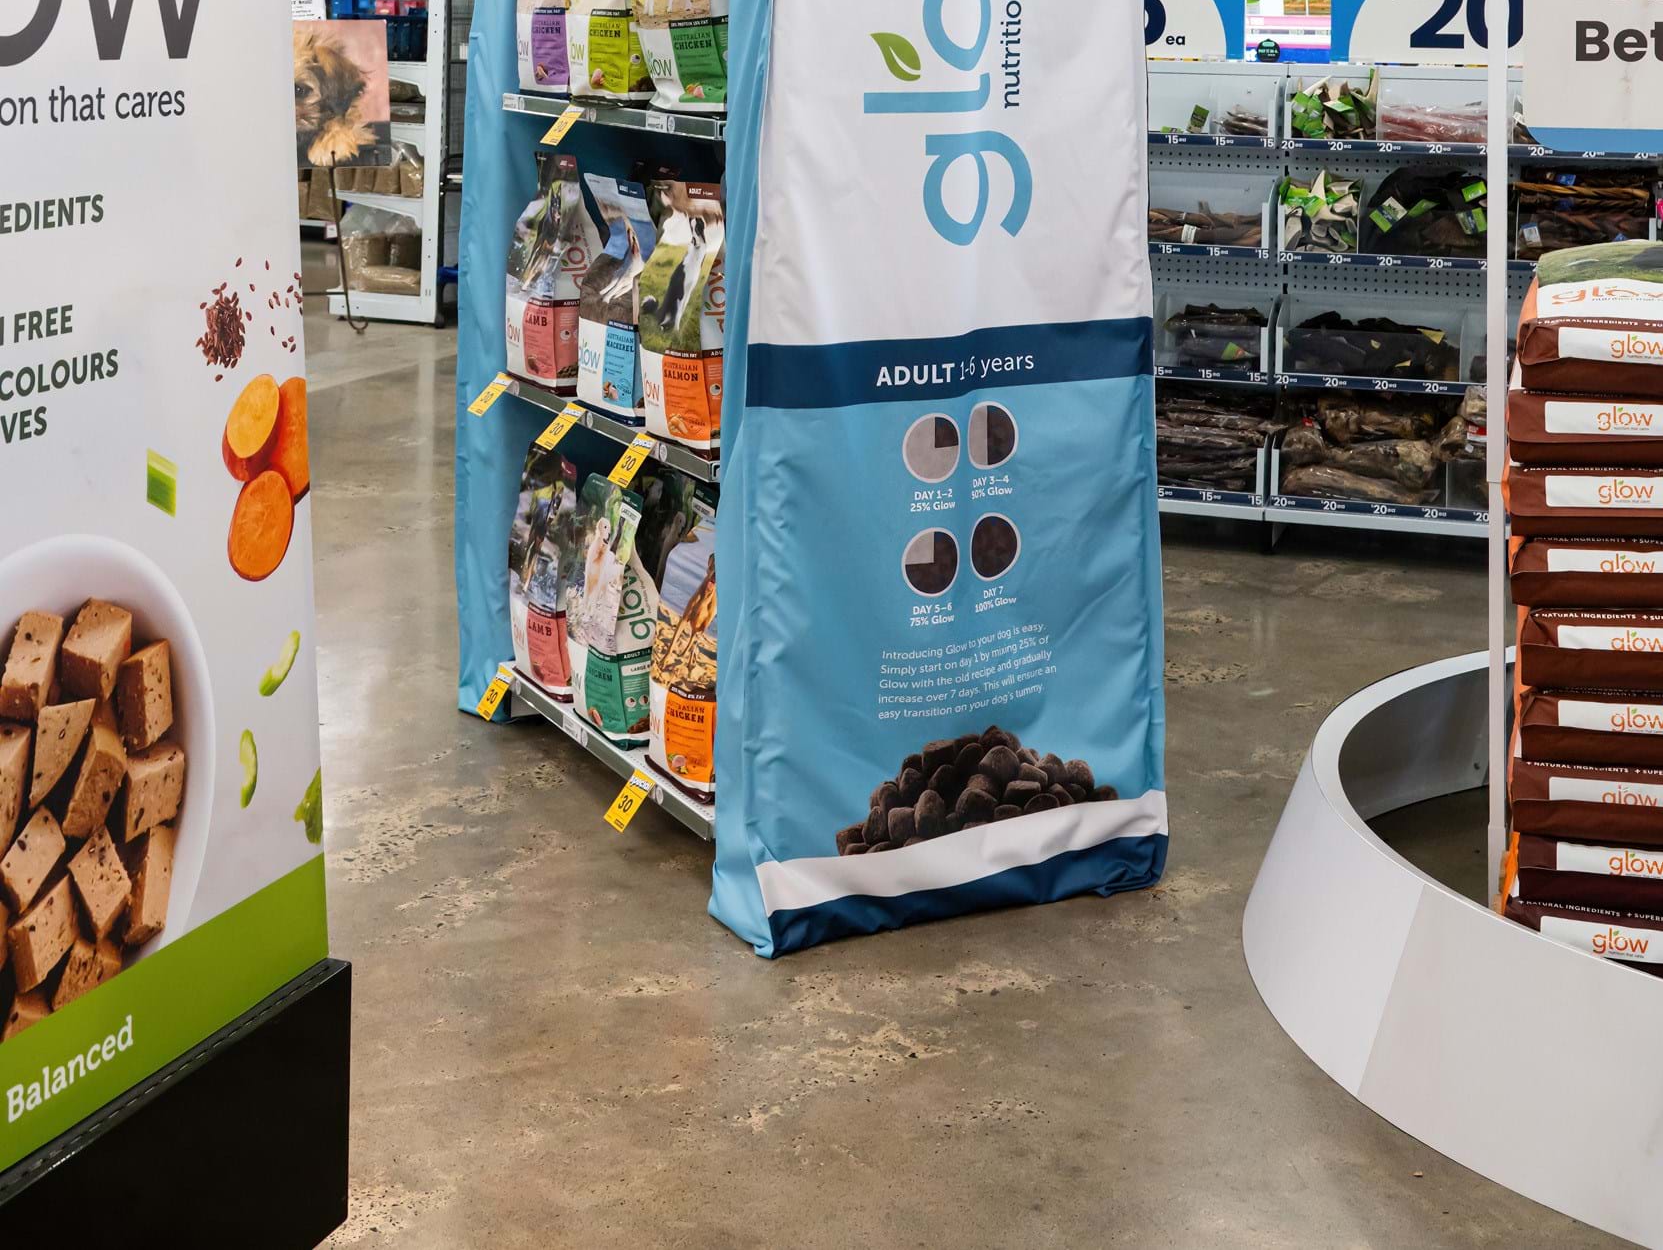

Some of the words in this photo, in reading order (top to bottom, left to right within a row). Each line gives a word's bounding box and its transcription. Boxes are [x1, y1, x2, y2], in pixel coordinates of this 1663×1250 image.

[589, 29, 621, 38] CHICKEN
[1165, 33, 1186, 46] ea
[674, 39, 712, 50] CHICKEN
[49, 86, 105, 123] that
[115, 90, 185, 119] cares
[0, 194, 104, 234] EDIENTS
[14, 305, 73, 343] FREE
[606, 340, 634, 353] MACKEREL
[0, 349, 118, 400] COLOURS
[664, 369, 698, 382] SALMON
[876, 363, 956, 386] ADULT
[960, 356, 975, 381] 1-6
[981, 354, 1034, 379] years
[1, 406, 47, 443] VES
[1597, 406, 1653, 431] glow
[972, 477, 986, 488] DAY
[987, 486, 1013, 496] Glow
[914, 491, 934, 501] DAY
[1598, 479, 1654, 504] glow
[910, 502, 931, 513] 25%
[933, 500, 956, 511] Glow
[983, 588, 997, 599] DAY
[998, 586, 1004, 595] 7
[912, 604, 933, 615] DAY
[975, 600, 994, 613] 100%
[995, 597, 1017, 607] Glow
[528, 619, 552, 636] LAMB
[909, 617, 929, 627] 75%
[931, 614, 954, 625] Glow
[882, 647, 943, 660] Introducing
[945, 642, 967, 655] Glow
[968, 640, 976, 649] to
[976, 634, 995, 649] your
[997, 629, 1011, 639] dog
[1013, 626, 1020, 635] is
[623, 651, 640, 659] ADULT
[880, 664, 917, 677] Simply
[920, 663, 942, 673] start
[944, 661, 957, 670] on
[959, 656, 973, 668] day
[980, 650, 990, 662] by
[992, 643, 1017, 658] mixing
[1019, 637, 1036, 650] 25%
[1038, 634, 1050, 645] of
[879, 679, 909, 689] Glow
[911, 678, 934, 688] with
[937, 676, 953, 686] the
[955, 672, 970, 683] old
[971, 666, 996, 680] recipe
[997, 659, 1012, 672] and
[1013, 650, 1052, 670] gradually
[878, 693, 923, 704] increase
[925, 692, 948, 702] over
[950, 689, 956, 699] 7
[983, 679, 1000, 692] This
[1001, 674, 1015, 687] will
[1017, 669, 1043, 682] ensure
[1044, 665, 1056, 674] an
[878, 710, 901, 720] easy
[903, 706, 952, 718] transition
[954, 703, 967, 713] on
[969, 699, 990, 712] your
[991, 691, 1014, 705] dog's
[667, 707, 704, 723] CHICKEN
[1526, 900, 1564, 909] NATURAL
[1566, 904, 1621, 917] INGREDIENTS
[1592, 928, 1649, 954] glow
[6, 1015, 133, 1123] Balanced
